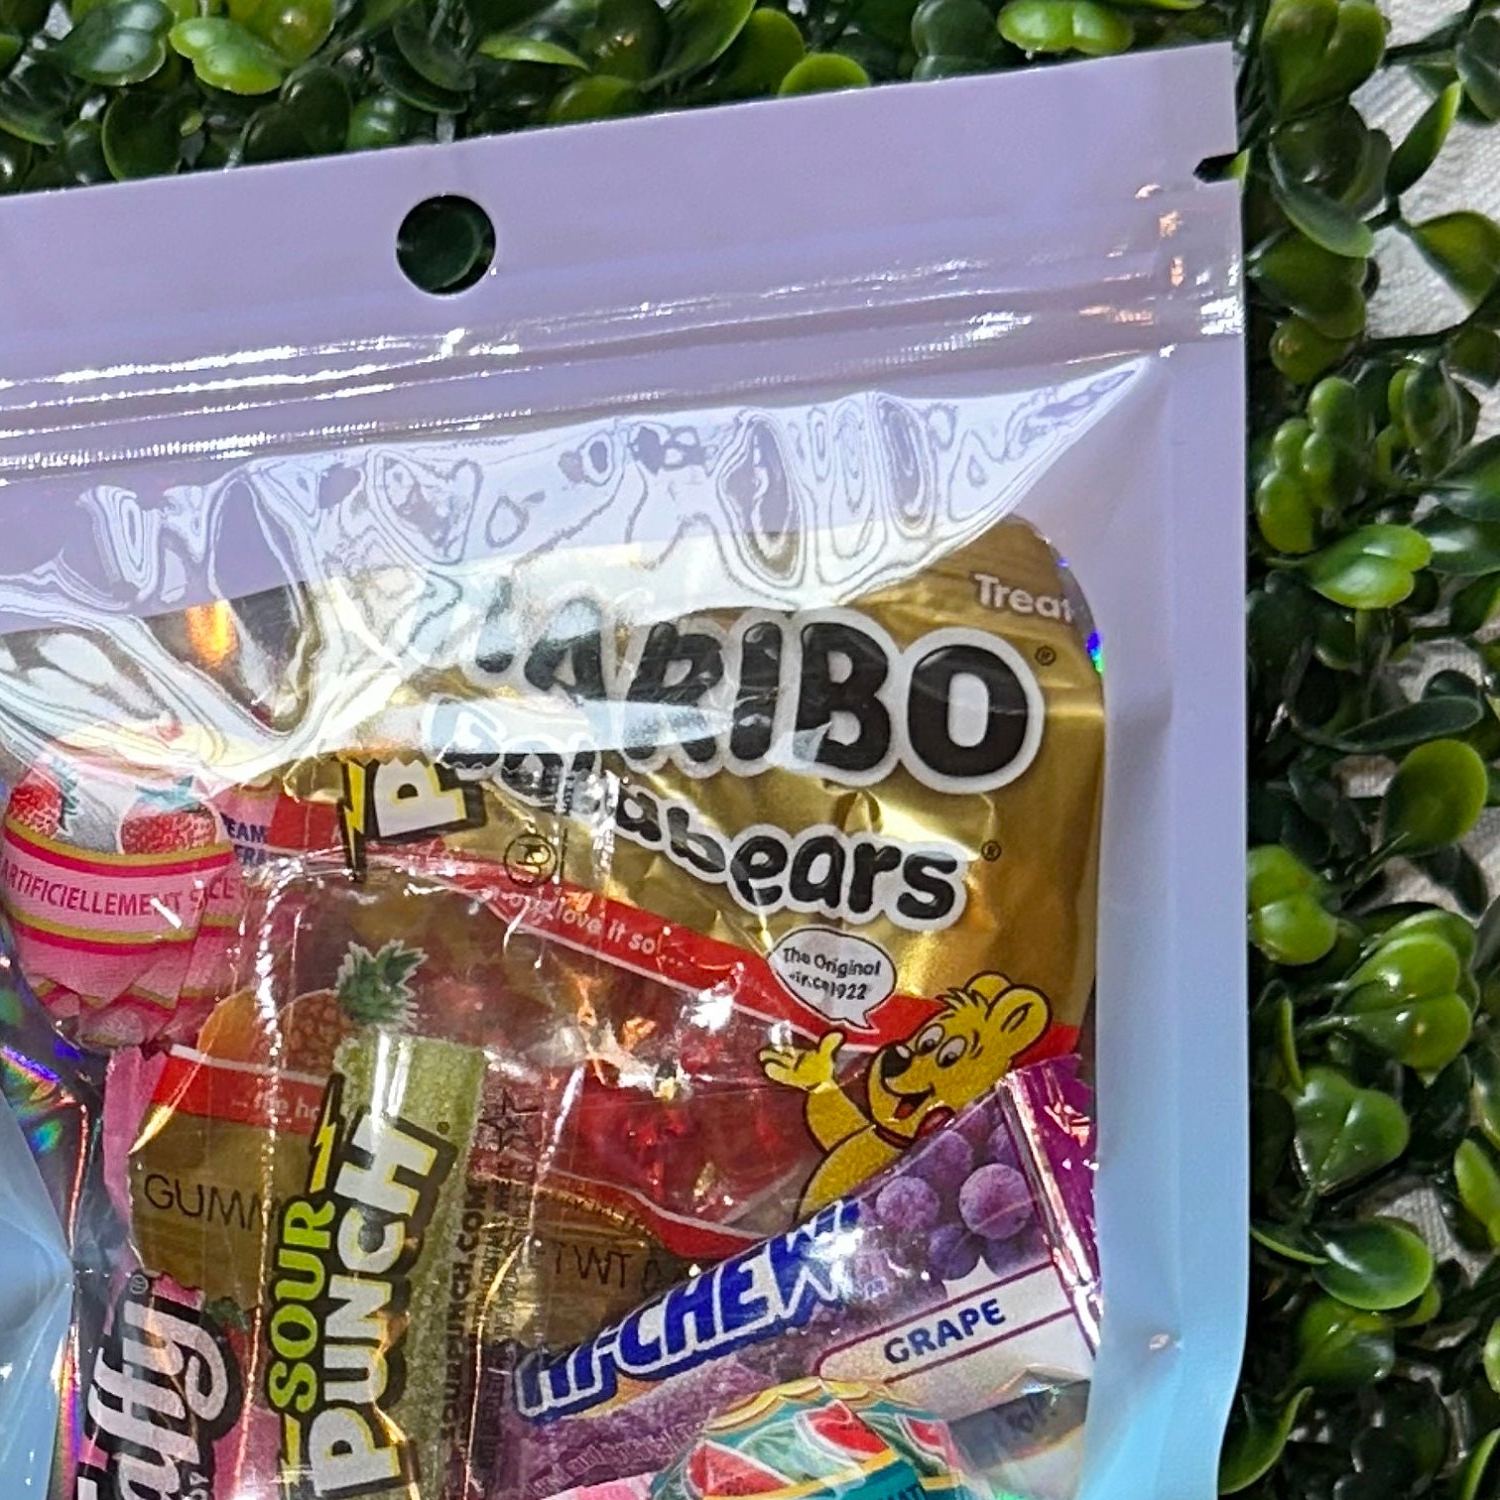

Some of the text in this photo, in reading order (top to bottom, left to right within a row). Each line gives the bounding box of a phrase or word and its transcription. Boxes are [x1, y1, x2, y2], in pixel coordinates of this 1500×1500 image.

[974, 573, 1076, 625] Treat
[465, 596, 1043, 792] ARIBO
[784, 946, 884, 980] The Original
[270, 1200, 339, 1415] SOUR
[310, 1112, 443, 1500] PUNCH
[884, 1298, 1007, 1365] GRAPE
